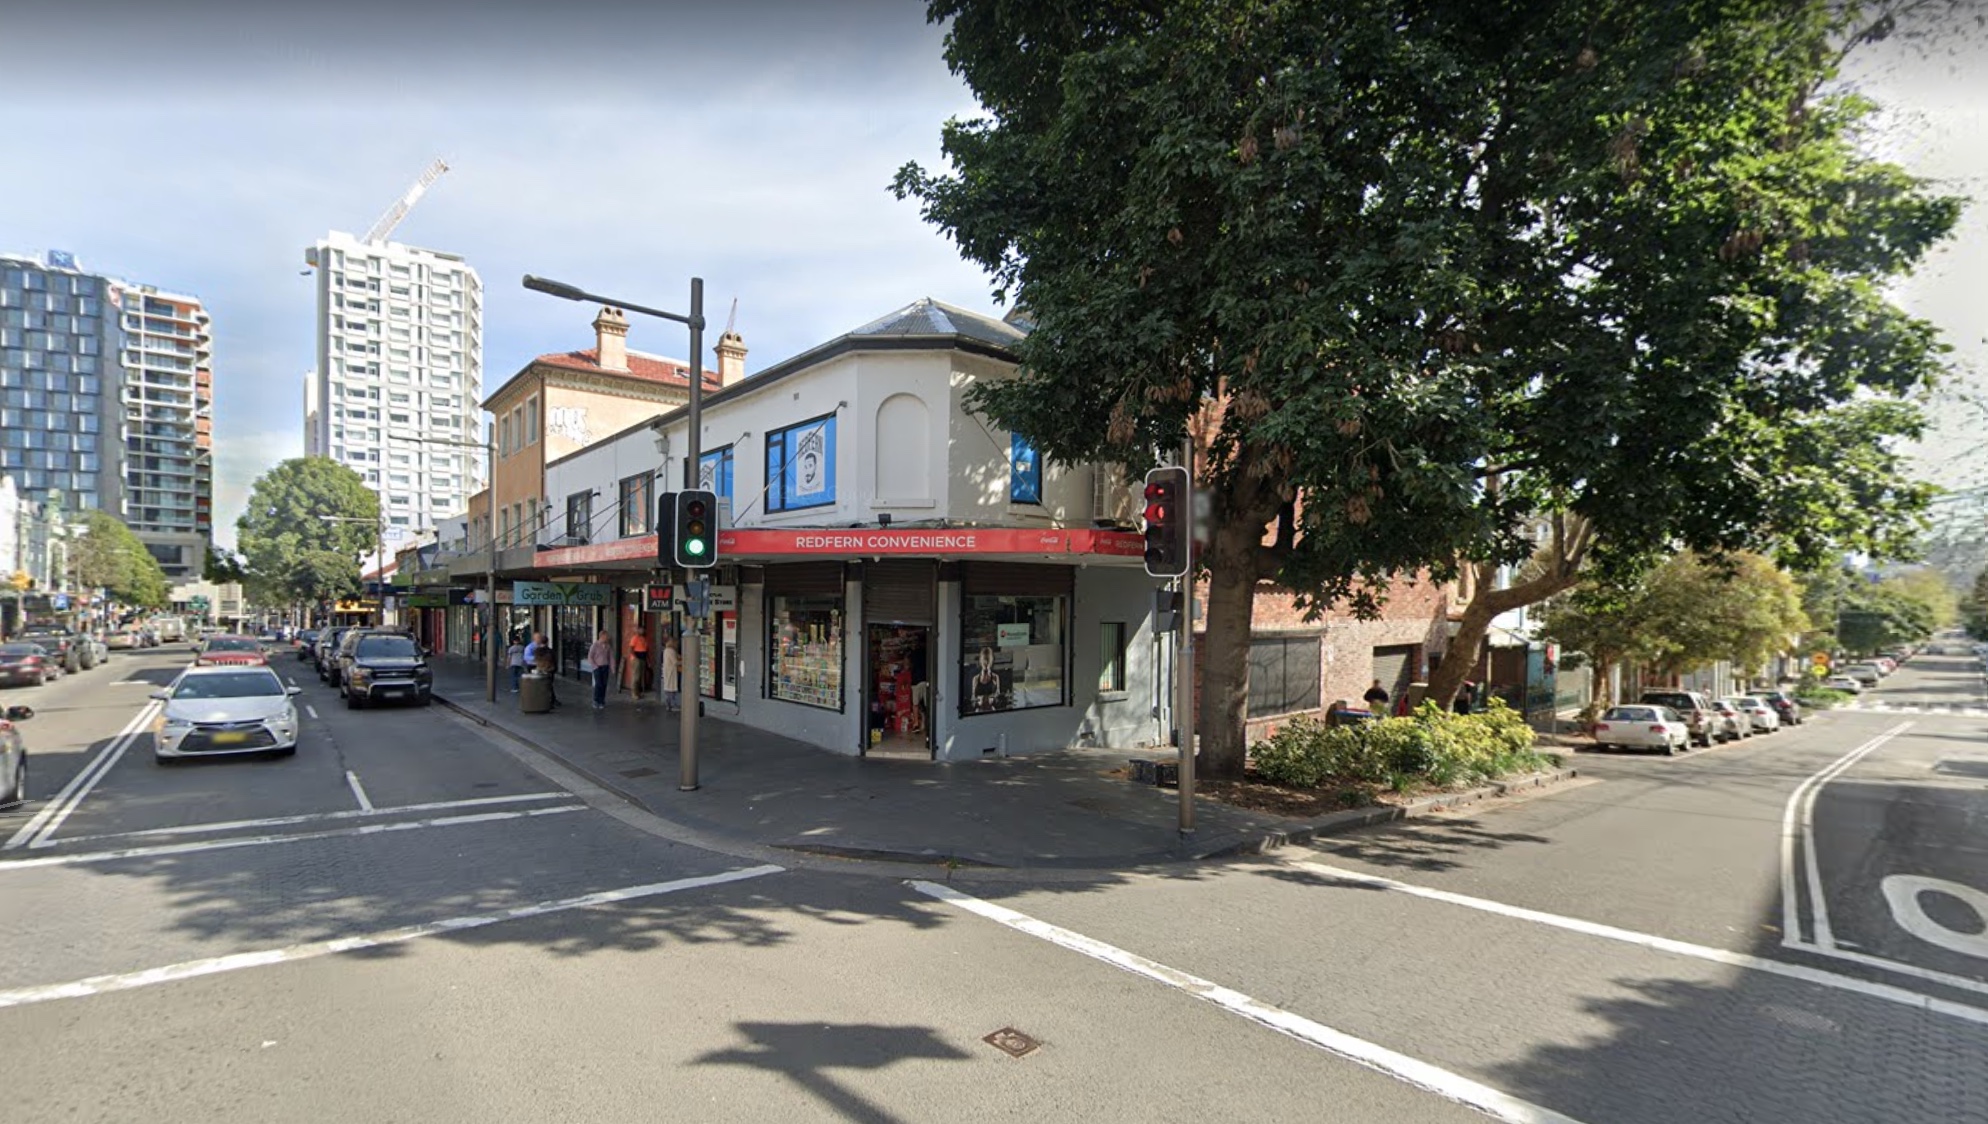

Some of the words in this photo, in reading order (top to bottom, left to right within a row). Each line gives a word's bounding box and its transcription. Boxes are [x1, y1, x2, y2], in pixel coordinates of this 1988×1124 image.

[796, 536, 863, 548] REDFERN
[867, 536, 976, 548] CONVENIENCE
[521, 588, 562, 601] Garden
[577, 589, 604, 601] Grub
[651, 600, 669, 608] ATM
